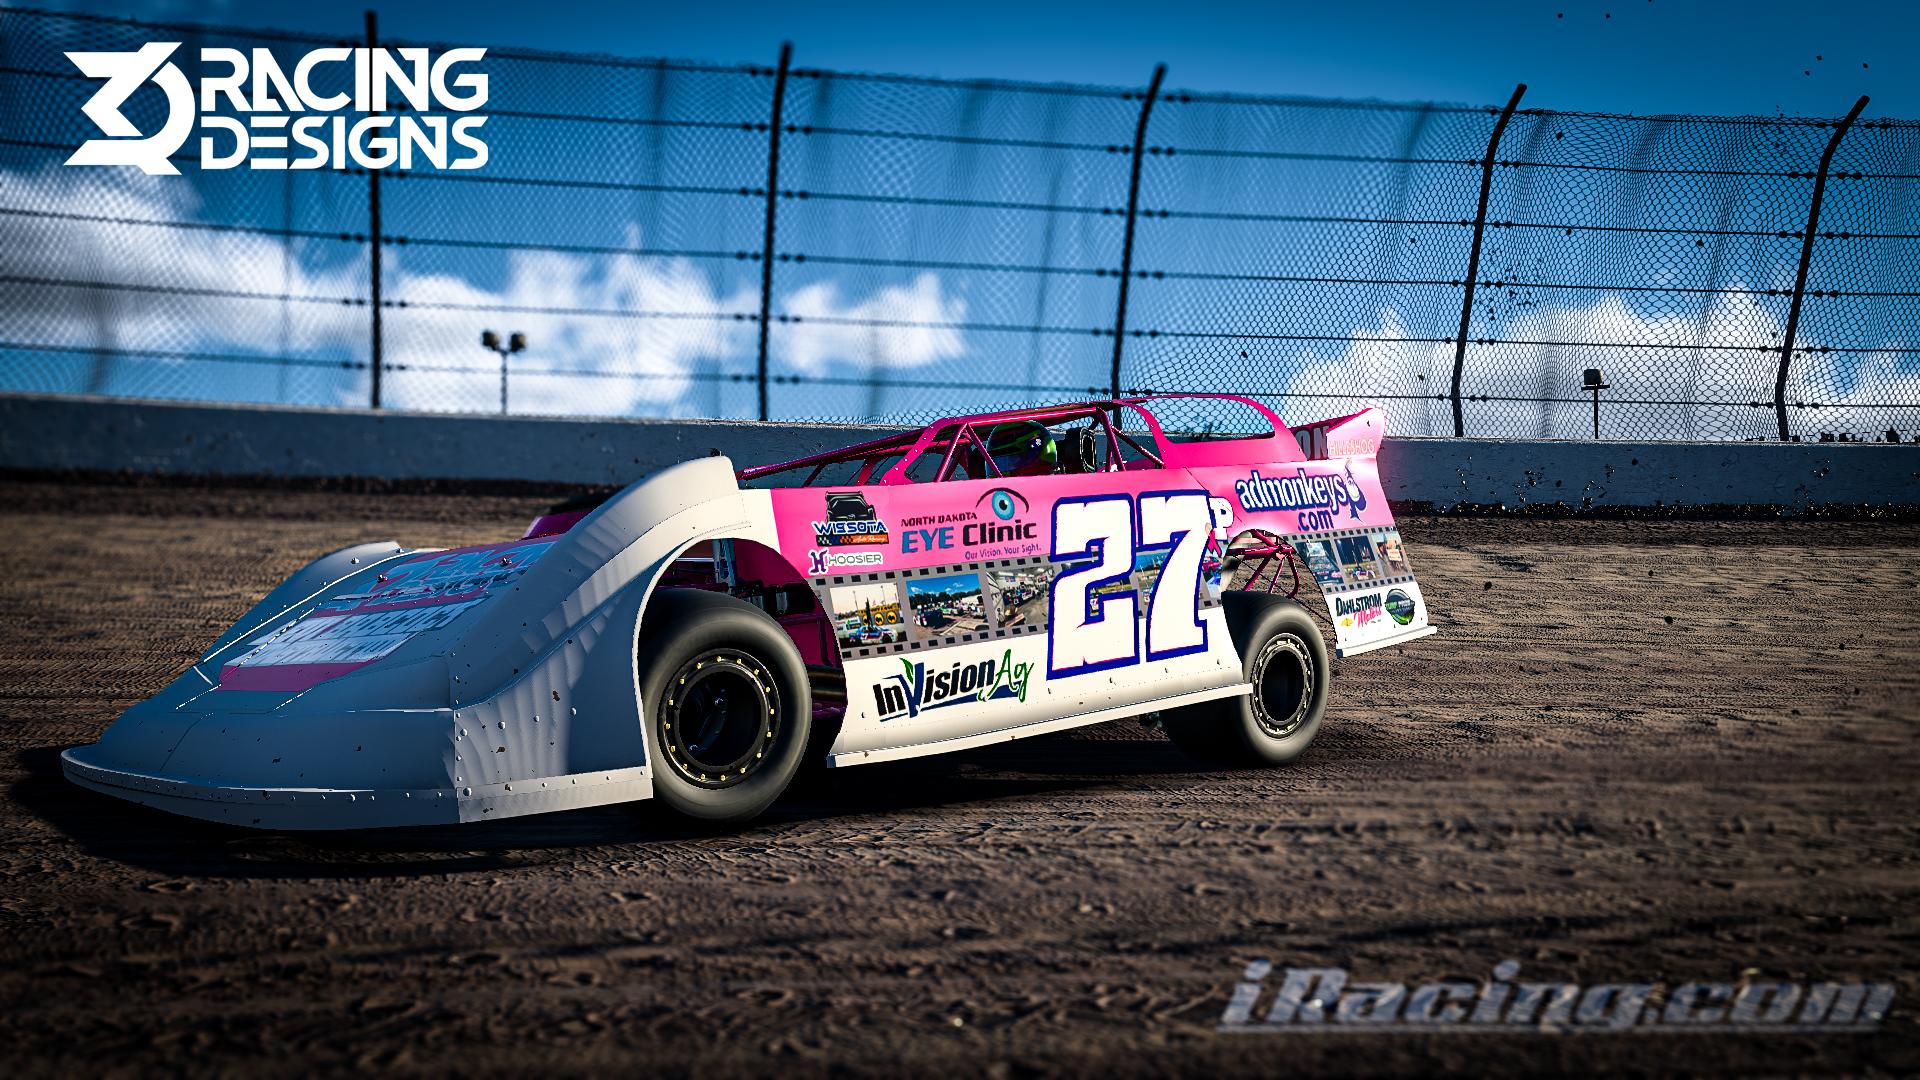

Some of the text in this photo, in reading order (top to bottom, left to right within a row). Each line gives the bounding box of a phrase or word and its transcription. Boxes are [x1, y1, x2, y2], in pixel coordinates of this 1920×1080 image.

[1235, 468, 1347, 515] admonkeys
[901, 512, 977, 527] NORTH DAKOTA
[812, 520, 888, 535] WISSOTA
[902, 519, 1037, 553] EYE Clinic
[829, 554, 882, 565] HOOSIER
[965, 550, 978, 560] Our
[1004, 545, 1020, 554] Your
[1047, 489, 1208, 680] 27
